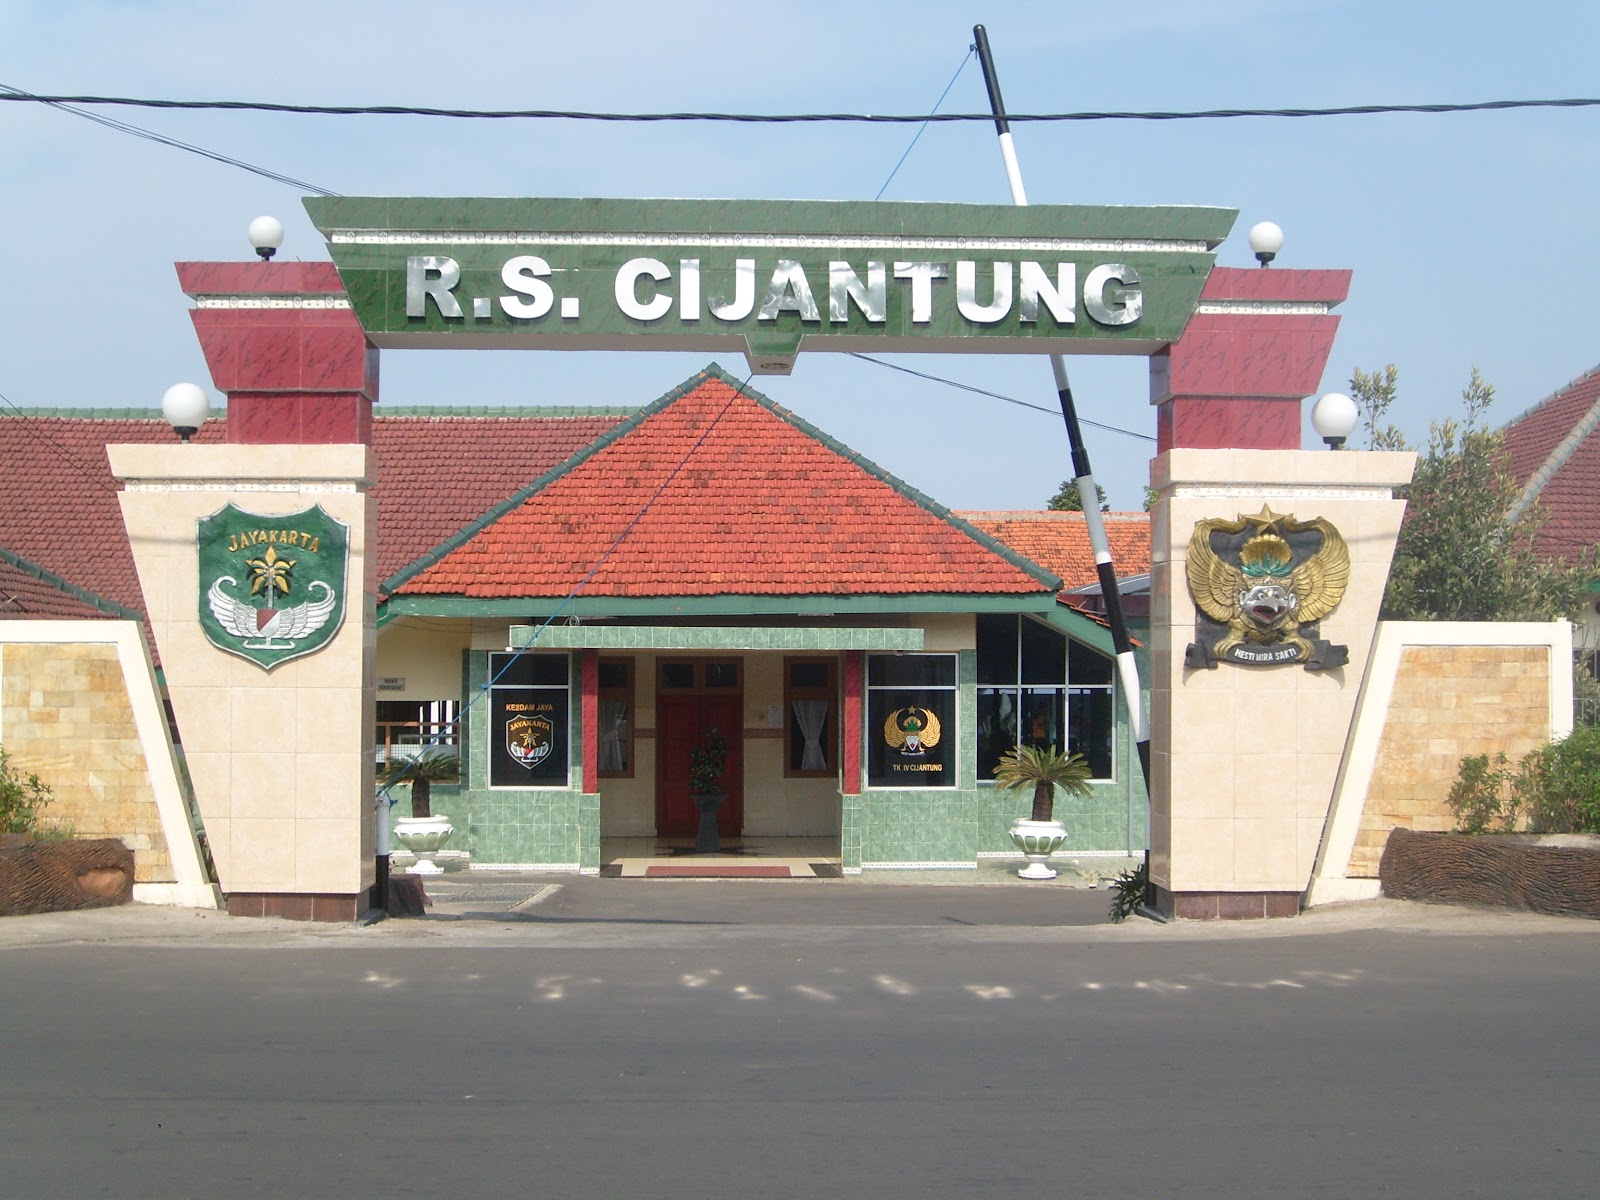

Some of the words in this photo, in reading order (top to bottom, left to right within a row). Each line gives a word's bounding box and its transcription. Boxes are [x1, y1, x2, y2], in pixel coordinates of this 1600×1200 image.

[405, 254, 580, 320] R.S.
[614, 257, 1143, 325] CIJANTUNG
[229, 530, 320, 553] JAYAKARTA
[1234, 648, 1255, 660] HESTI
[1275, 648, 1297, 660] SAKTI
[506, 704, 535, 712] KESDAM
[510, 720, 549, 731] JAYAKARTA
